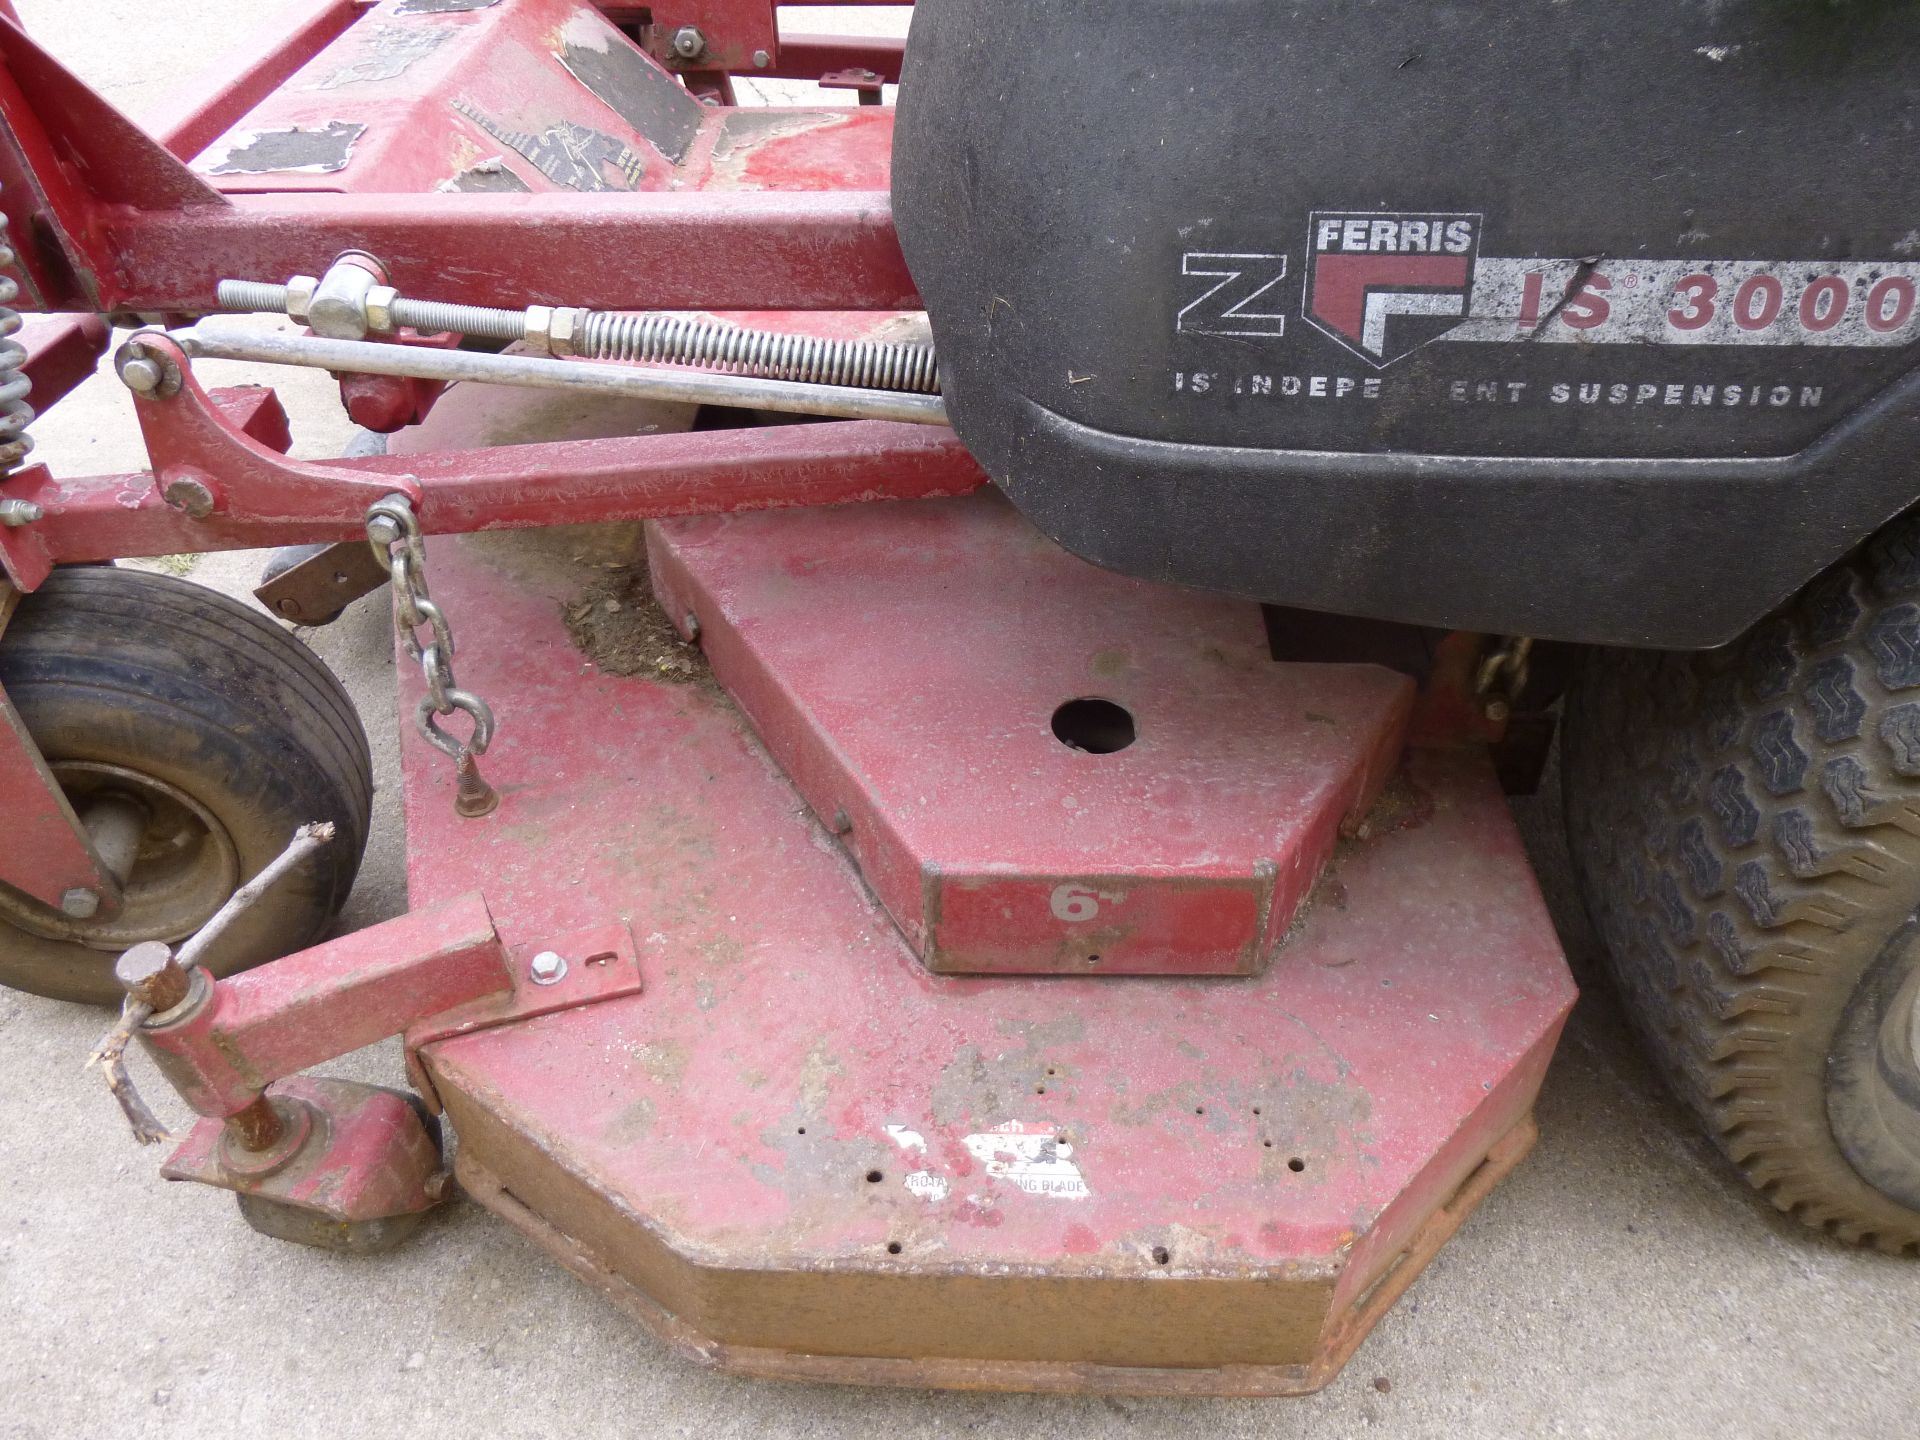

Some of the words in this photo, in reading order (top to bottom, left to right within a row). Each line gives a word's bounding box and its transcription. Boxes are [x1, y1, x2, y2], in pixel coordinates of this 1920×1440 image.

[1316, 219, 1472, 253] FERRIS
[1177, 252, 1288, 337] Z
[1667, 273, 1917, 333] 3000
[1234, 374, 1527, 403] INDEPEENT
[1550, 382, 1824, 408] SUSPENSION
